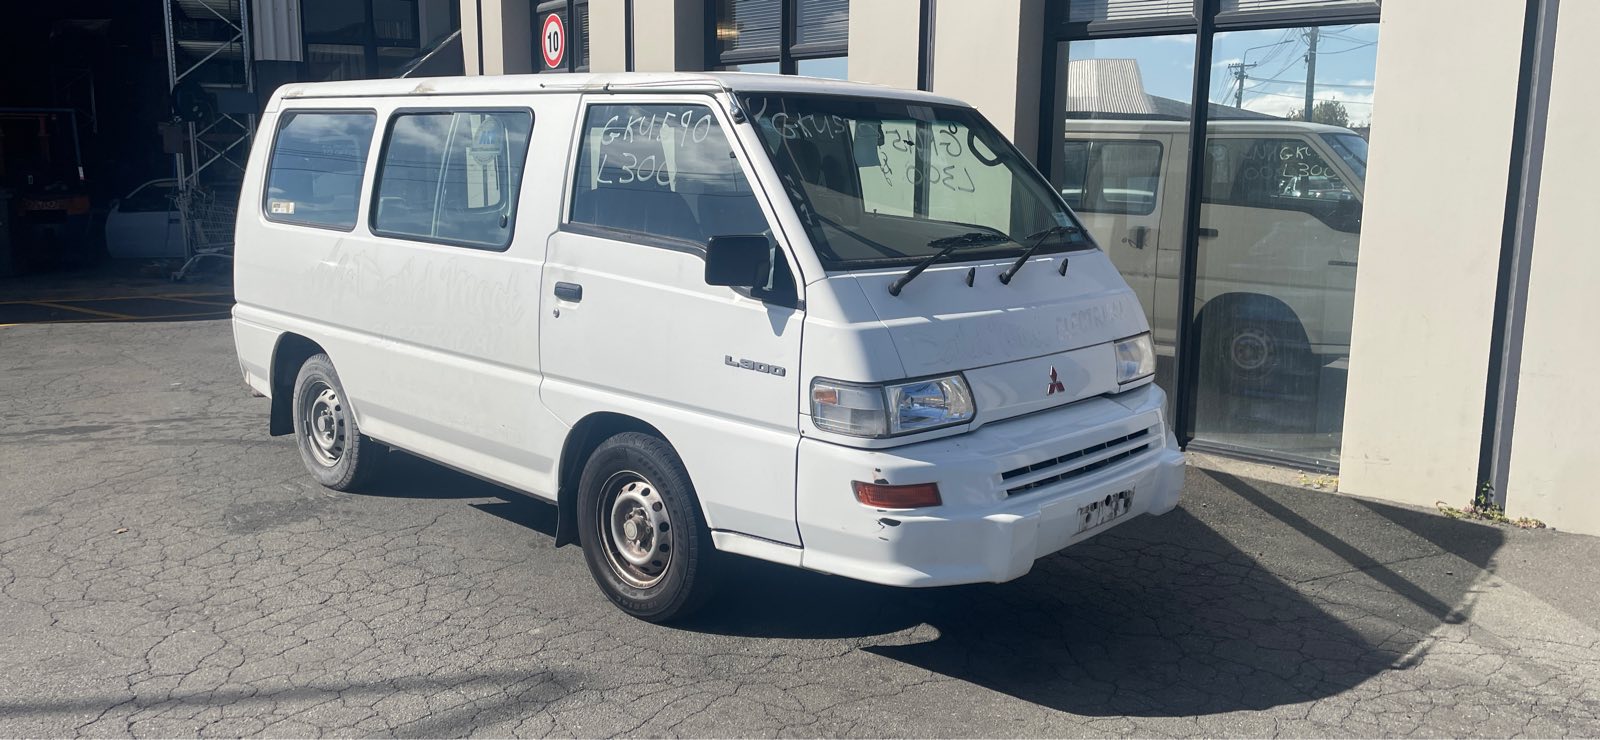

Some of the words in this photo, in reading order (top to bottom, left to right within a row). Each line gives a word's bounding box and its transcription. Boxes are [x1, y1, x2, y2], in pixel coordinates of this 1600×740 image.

[547, 30, 559, 53] 10
[597, 152, 677, 186] L300
[724, 354, 786, 377] L300
